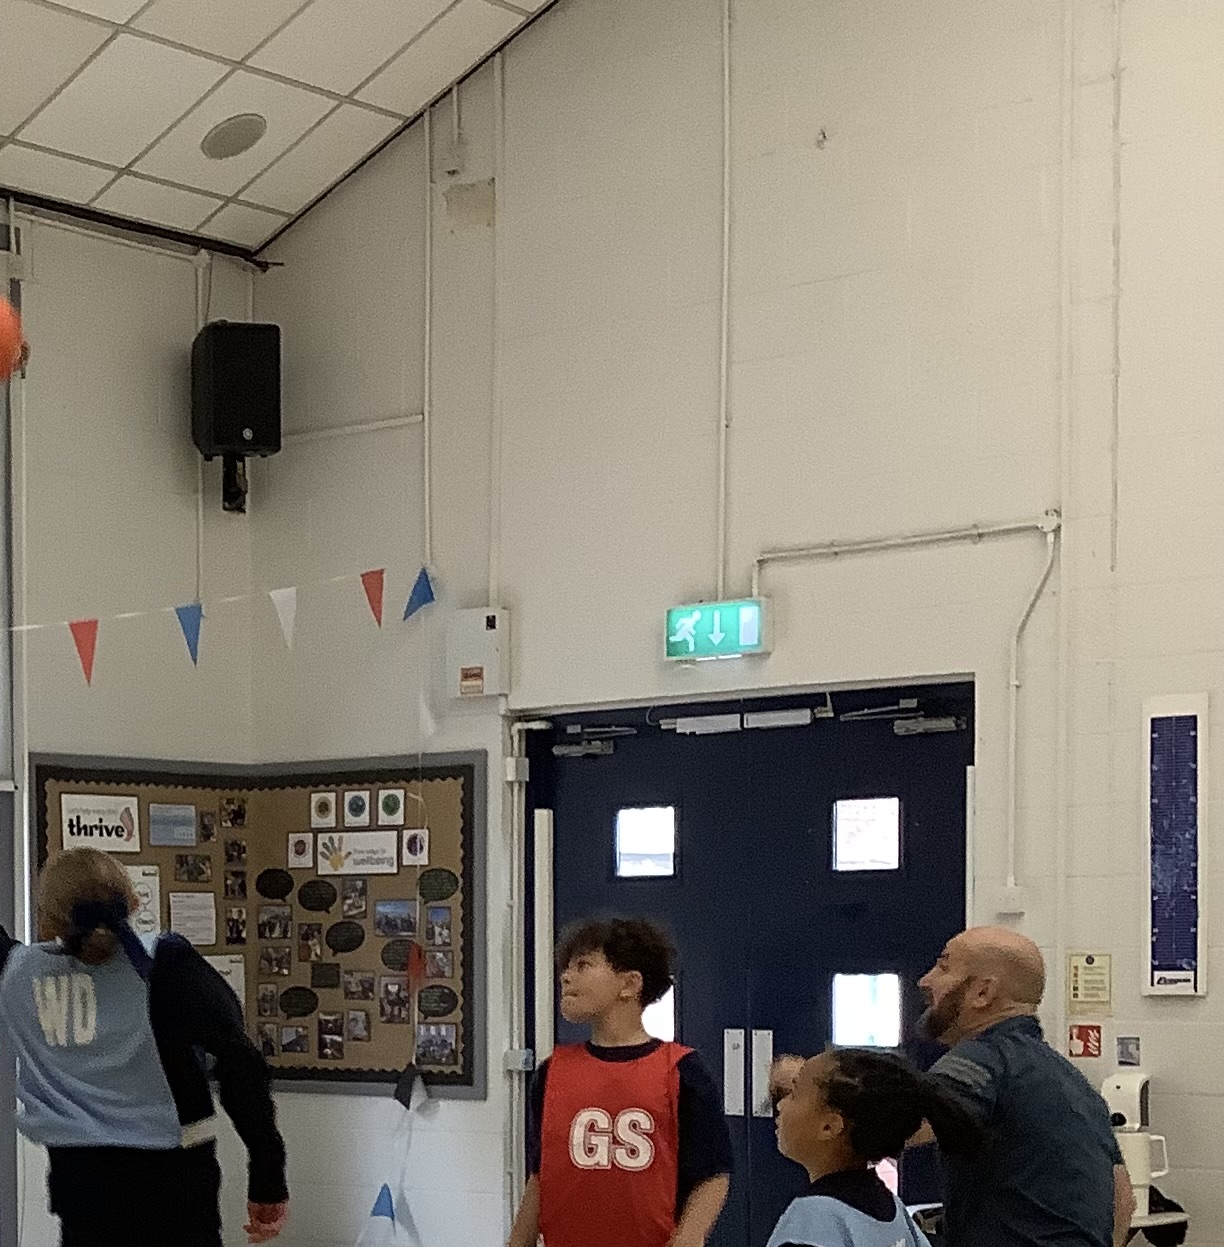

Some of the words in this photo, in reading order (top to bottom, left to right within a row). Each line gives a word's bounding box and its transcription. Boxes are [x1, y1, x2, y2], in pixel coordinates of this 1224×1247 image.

[68, 815, 125, 838] thrive
[32, 973, 97, 1047] WD
[569, 1107, 655, 1172] GS
